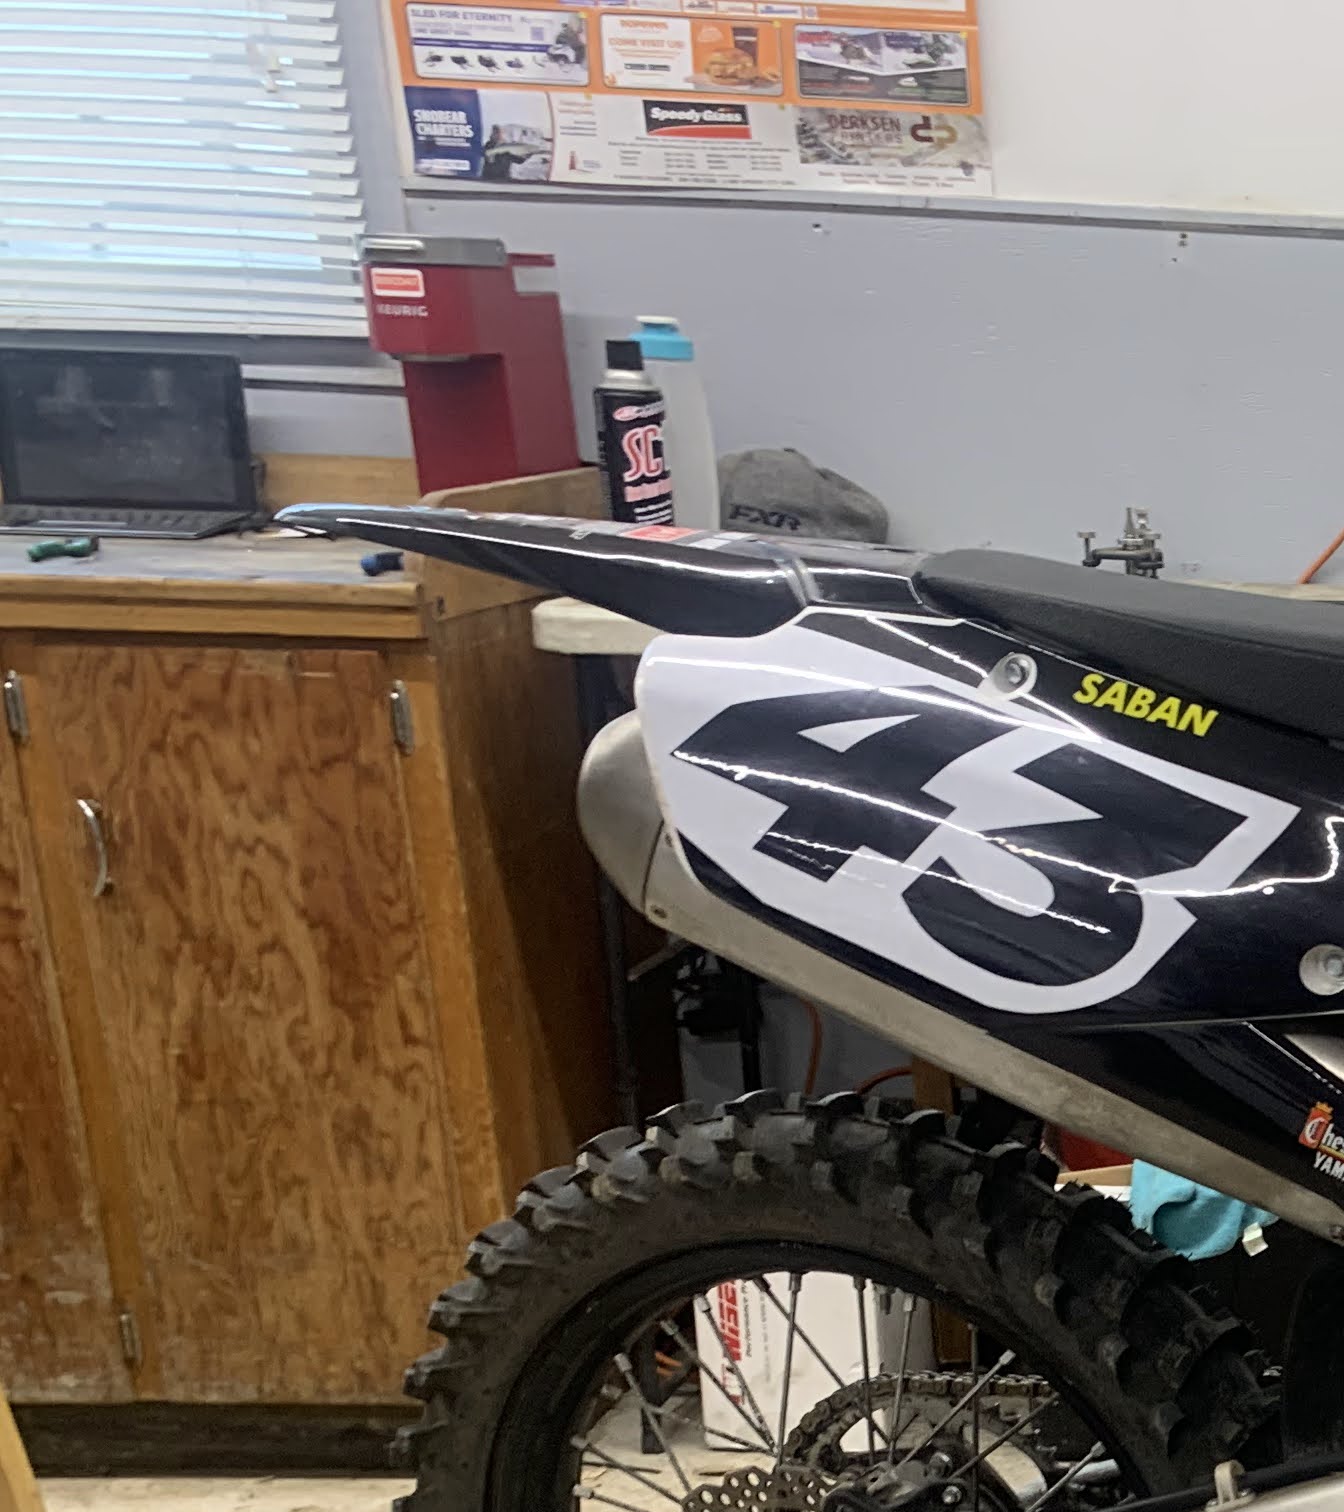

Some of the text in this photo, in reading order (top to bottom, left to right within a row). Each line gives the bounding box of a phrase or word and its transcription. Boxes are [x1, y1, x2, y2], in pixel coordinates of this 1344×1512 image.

[376, 304, 428, 316] KEURIG
[622, 424, 670, 482] SC
[1072, 672, 1219, 737] SABAN
